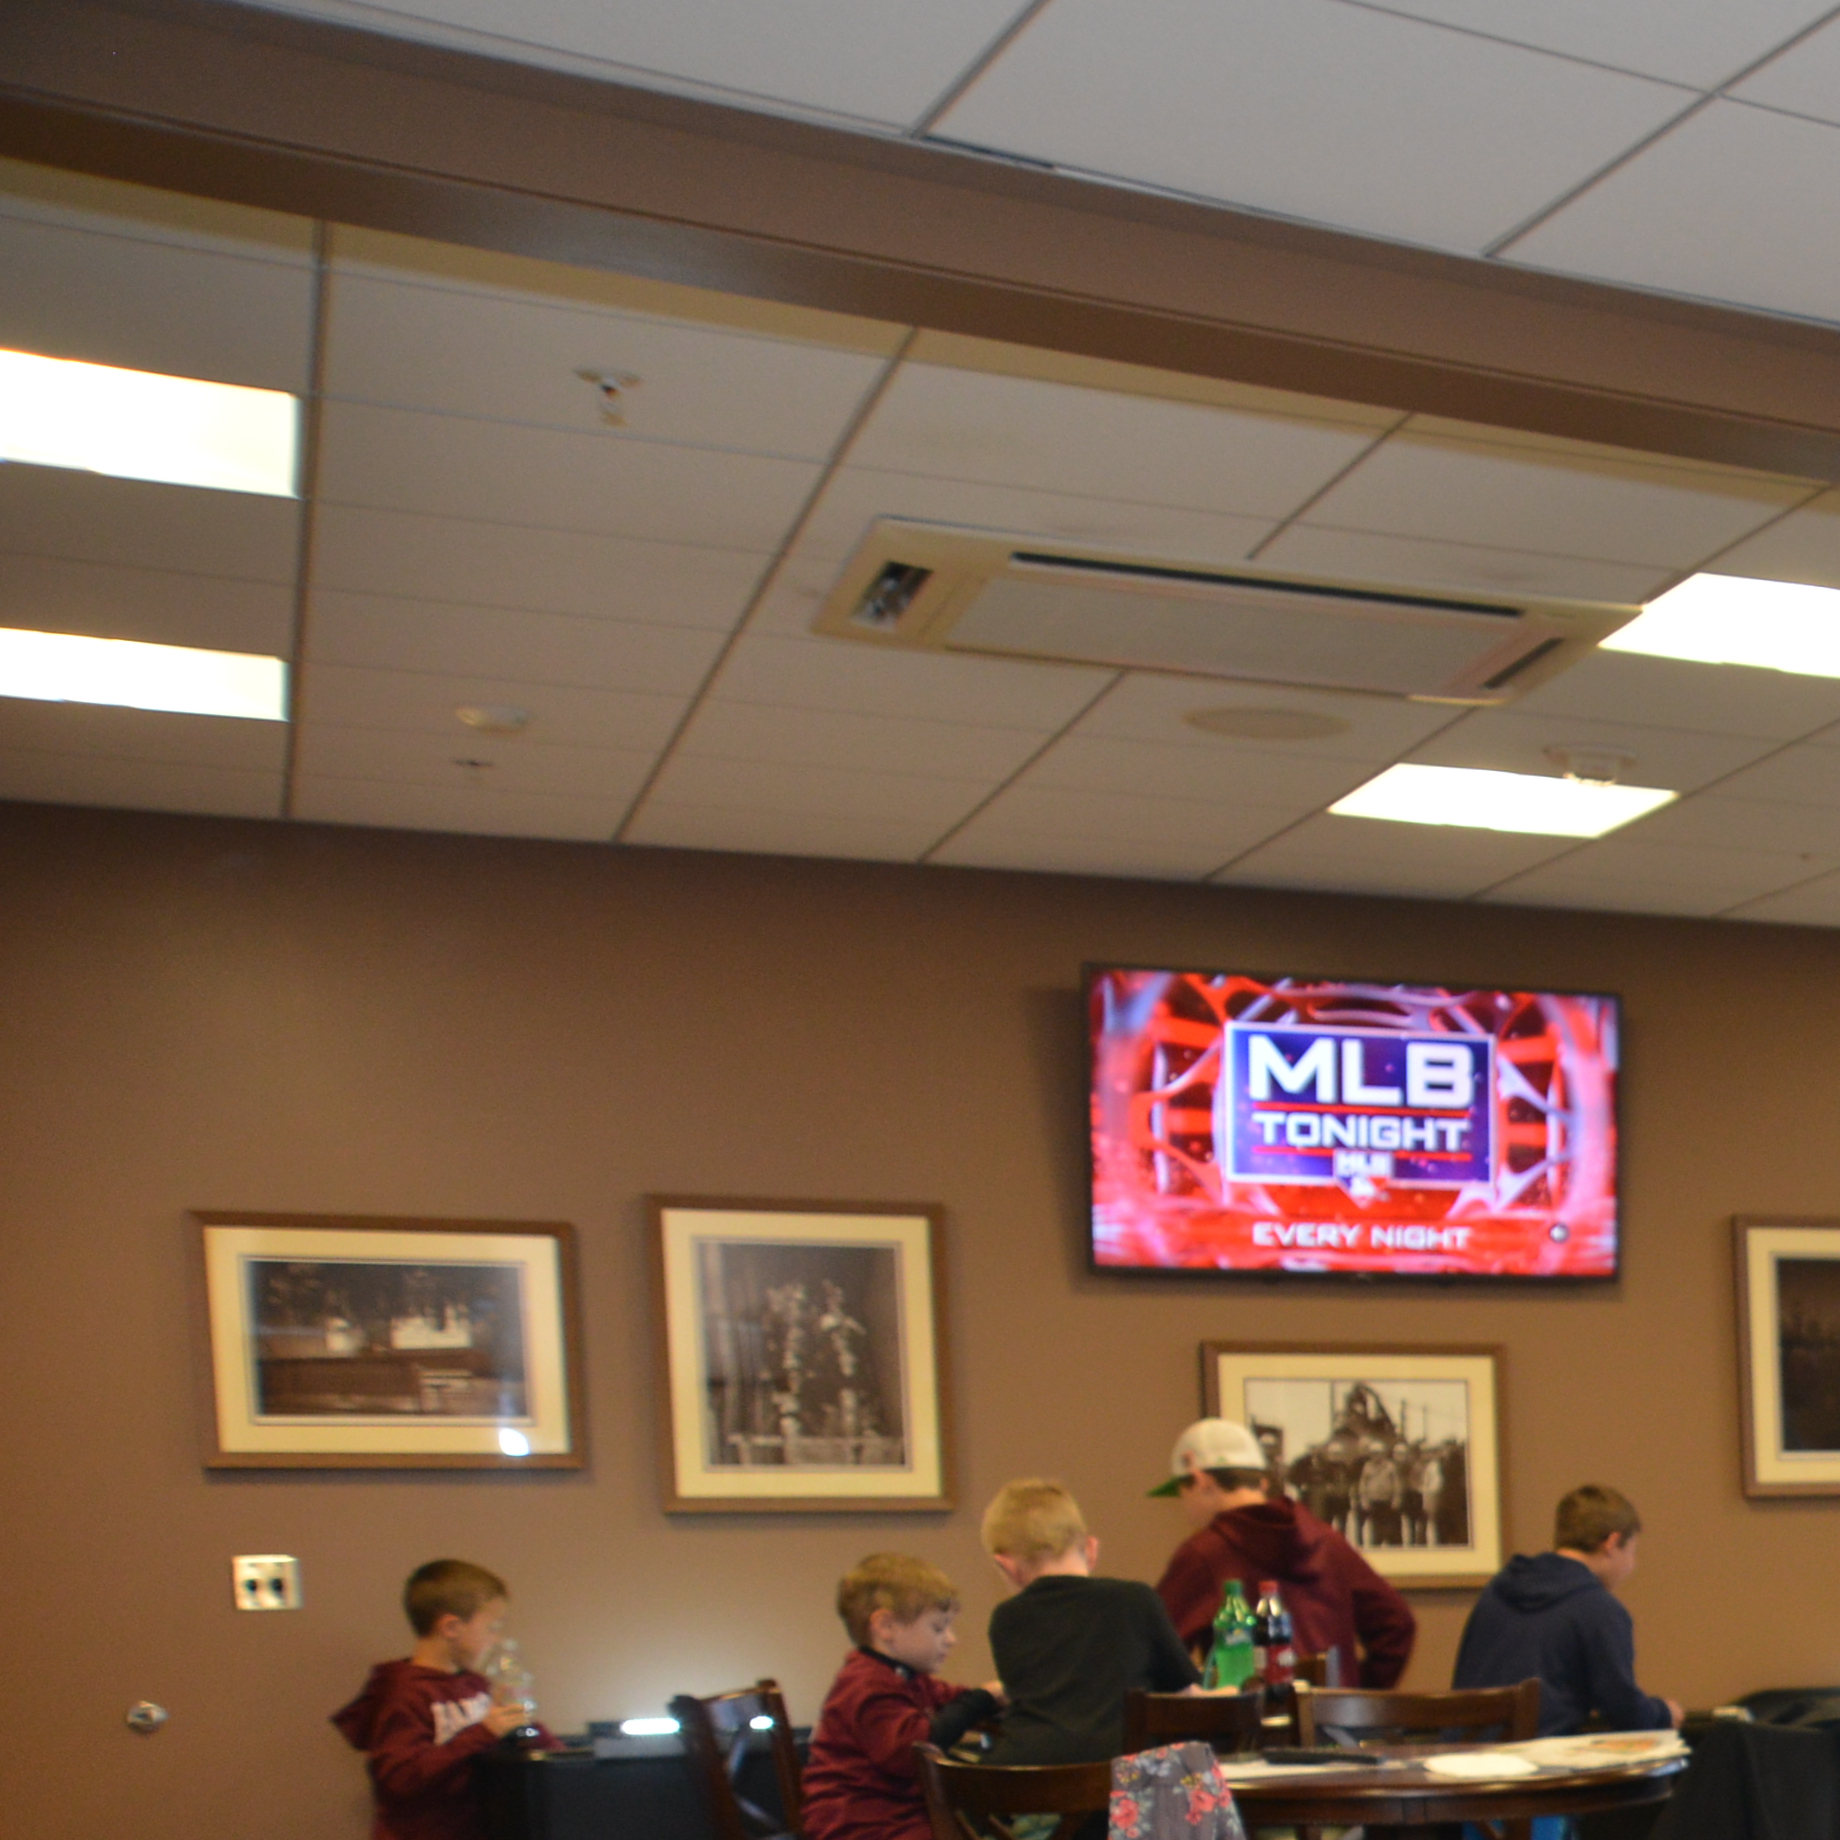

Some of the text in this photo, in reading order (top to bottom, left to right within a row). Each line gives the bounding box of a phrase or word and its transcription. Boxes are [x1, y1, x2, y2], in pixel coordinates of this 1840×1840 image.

[1247, 1034, 1474, 1109] MLB
[1253, 1112, 1471, 1152] TONIGHT
[1252, 1221, 1471, 1251] EVERY NIGHT
